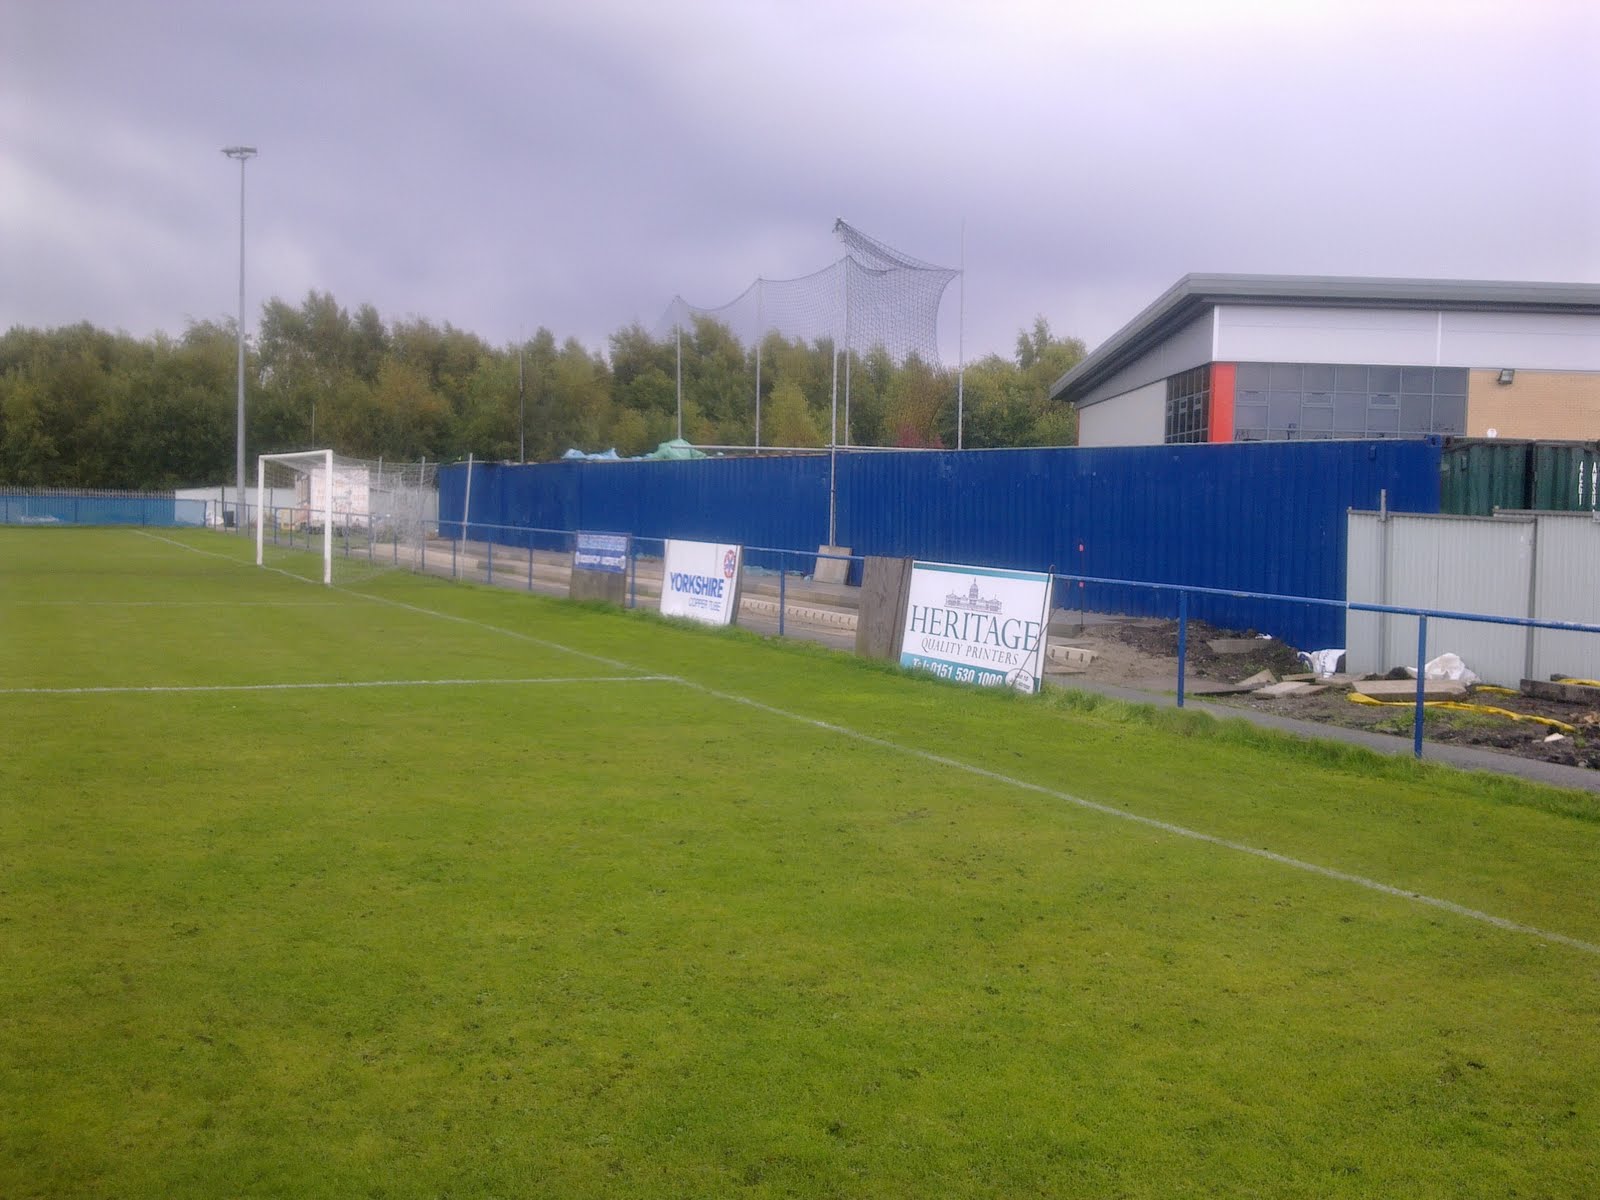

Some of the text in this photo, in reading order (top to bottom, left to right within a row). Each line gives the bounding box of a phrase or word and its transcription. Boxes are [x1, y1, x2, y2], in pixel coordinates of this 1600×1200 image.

[670, 572, 724, 598] YORKSHIRE
[910, 605, 1040, 652] HERITAGE
[921, 637, 1019, 666] QUALITY PRINTERS
[955, 668, 975, 682] 530
